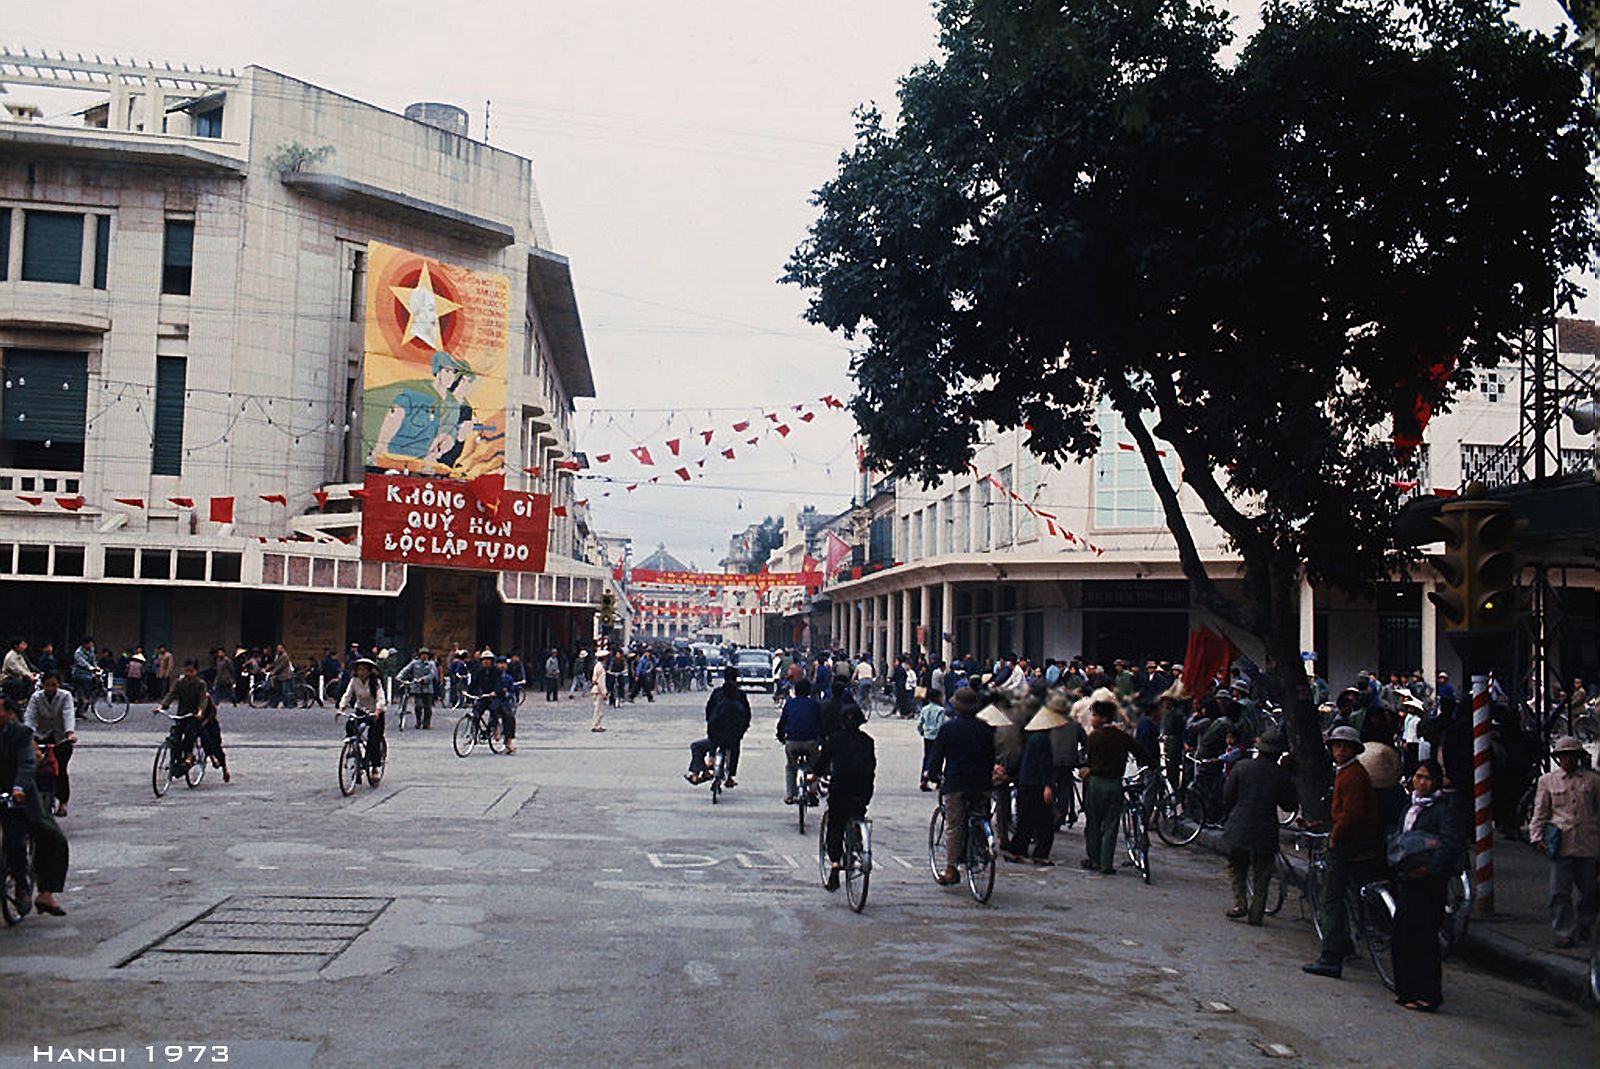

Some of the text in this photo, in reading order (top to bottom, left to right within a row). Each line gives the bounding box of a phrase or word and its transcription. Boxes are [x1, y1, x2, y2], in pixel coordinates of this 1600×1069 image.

[387, 483, 465, 509] KHÔNG
[513, 493, 535, 518] GÌ
[431, 530, 469, 559] LẬP
[503, 542, 530, 561] DO
